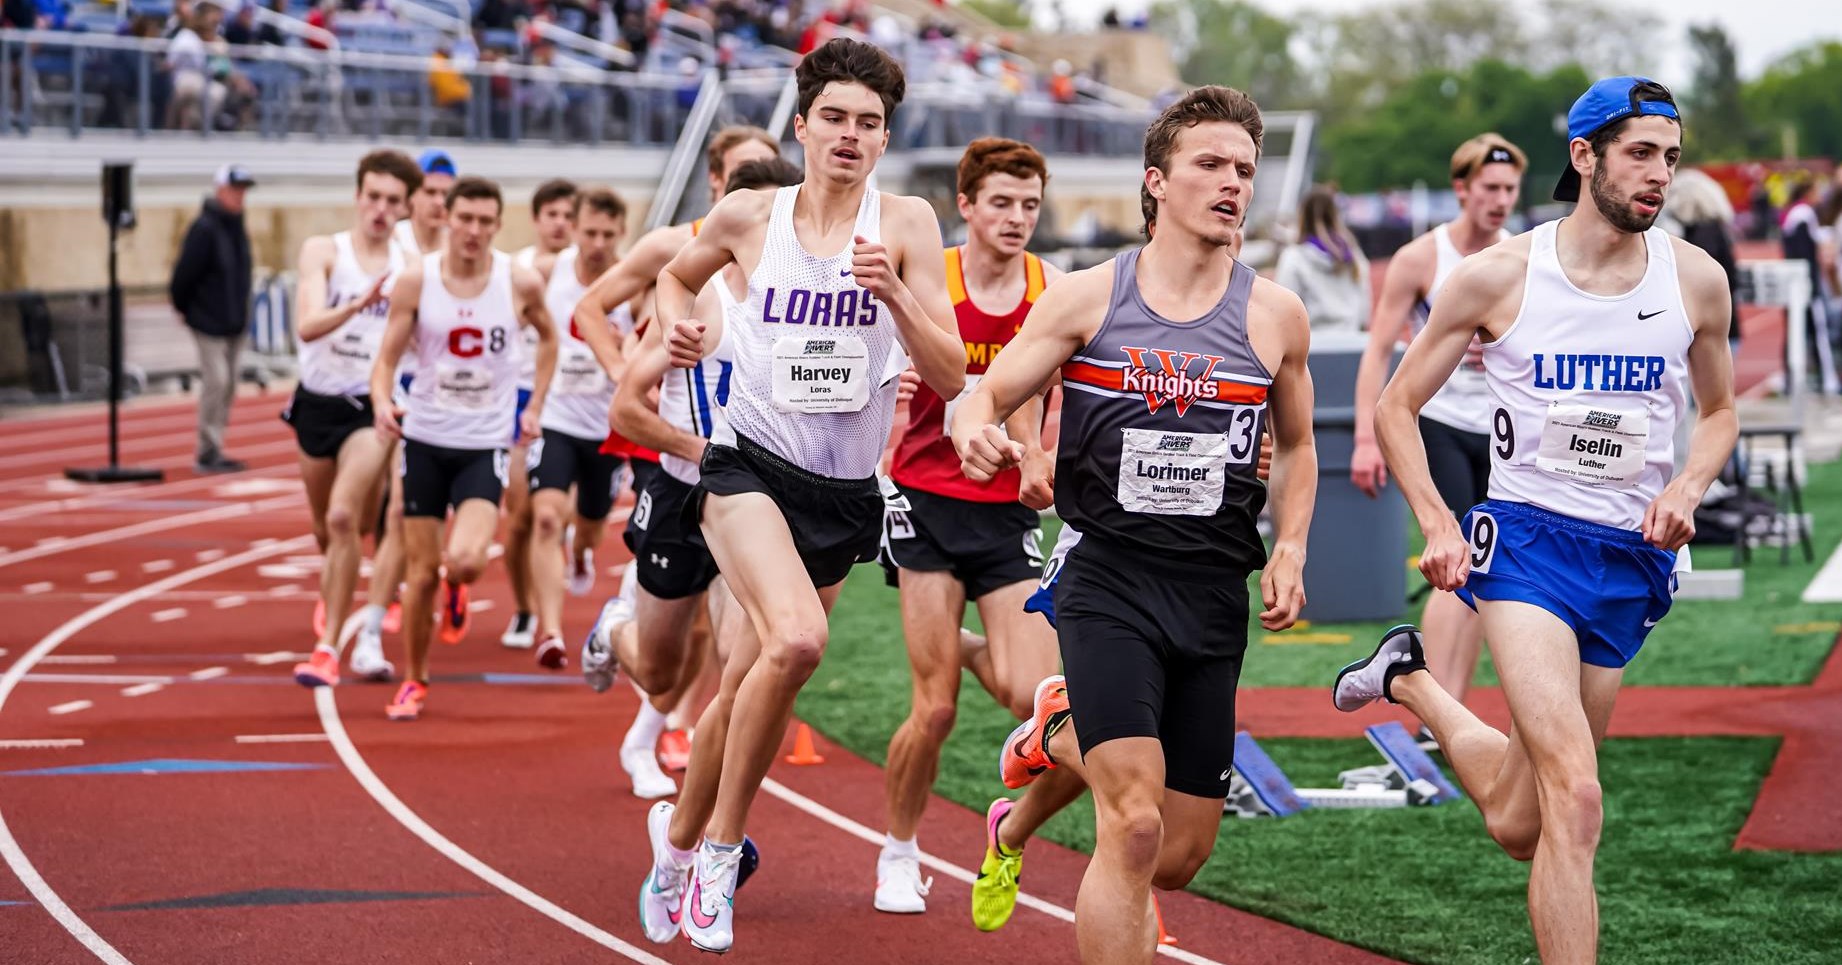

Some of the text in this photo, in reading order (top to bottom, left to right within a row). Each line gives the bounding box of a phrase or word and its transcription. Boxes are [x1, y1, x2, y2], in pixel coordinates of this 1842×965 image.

[763, 287, 878, 327] LORAS
[448, 327, 484, 358] C
[489, 326, 505, 353] 8
[791, 365, 852, 384] Harvey
[1123, 366, 1219, 401] Knights
[1533, 354, 1666, 392] LUTHER
[810, 386, 832, 394] Loras
[1588, 410, 1622, 420] AMERICAN
[1162, 434, 1194, 442] AMERICAN
[1230, 408, 1256, 460] 3
[1494, 408, 1515, 460] 9
[1569, 434, 1623, 458] Iselin
[1136, 460, 1210, 481] Lorimer
[1577, 471, 1599, 480] University
[1578, 458, 1606, 470] Luther
[1152, 484, 1190, 495] Wartburg
[1471, 516, 1494, 568] 9
